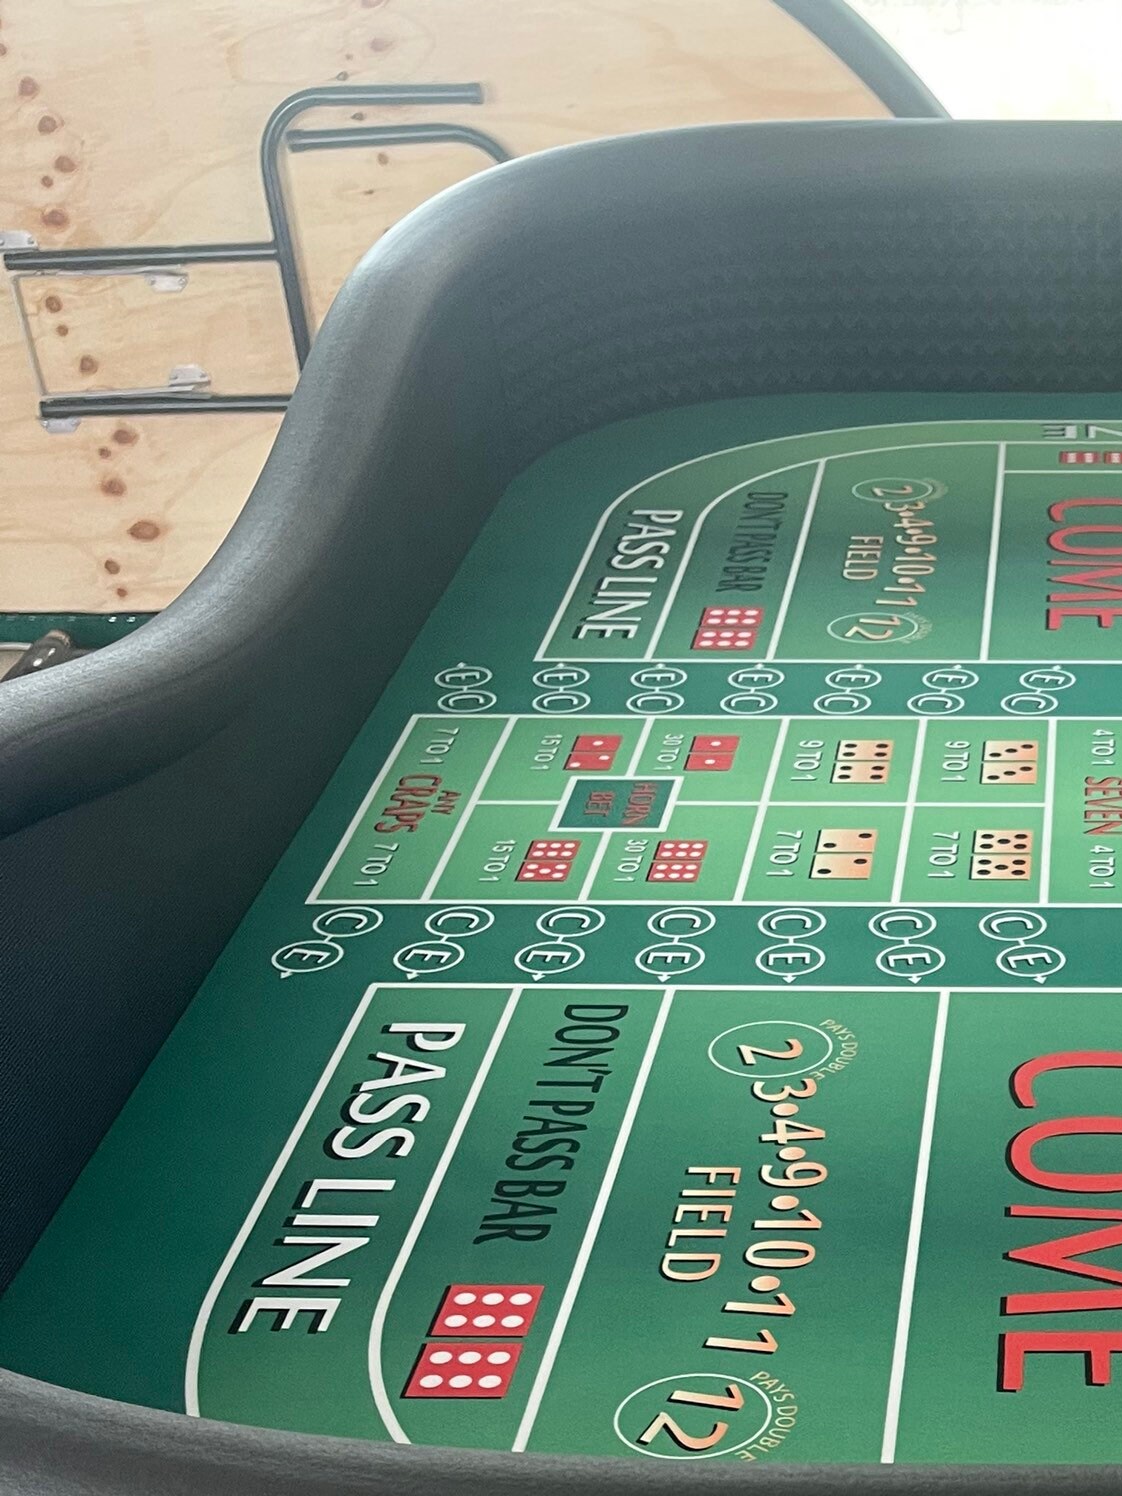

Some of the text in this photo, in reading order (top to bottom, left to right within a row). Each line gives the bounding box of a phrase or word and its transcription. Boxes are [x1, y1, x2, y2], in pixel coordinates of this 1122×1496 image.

[871, 485, 912, 496] 2
[726, 533, 777, 563] PASS
[842, 535, 884, 580] FIELD
[572, 509, 684, 639] PASS LINE
[844, 616, 900, 640] 12
[437, 727, 460, 735] 7
[540, 733, 563, 746] 15
[662, 733, 685, 746] 30
[1092, 728, 1114, 736] 4
[425, 736, 455, 755] TO
[798, 739, 824, 748] 9
[944, 740, 970, 749] 9
[1091, 738, 1115, 756] TO
[533, 746, 558, 762] TO
[656, 747, 680, 763] TO
[793, 750, 822, 770] TO
[942, 751, 969, 771] TO
[374, 774, 442, 833] CRAPS
[431, 790, 461, 814] ANY
[583, 792, 615, 817] BET
[776, 829, 803, 839] 7
[932, 830, 960, 840] 7
[374, 842, 399, 851] 7
[491, 839, 517, 853] 15
[624, 839, 649, 853] 30
[769, 841, 801, 864] TO
[928, 843, 958, 866] TO
[1089, 844, 1114, 854] 4
[360, 854, 393, 875] TO
[483, 854, 510, 873] TO
[617, 855, 643, 873] TO
[1088, 856, 1115, 877] TO
[737, 1038, 803, 1065] 2
[809, 1019, 858, 1080] PAYS DOUBLE
[473, 1003, 629, 1245] DON'T PASS BAR
[228, 1022, 467, 1334] PASS LINE
[659, 1166, 741, 1282] FIELD
[636, 1383, 745, 1451] 12
[735, 1371, 798, 1462] PAYS DOUBLE
